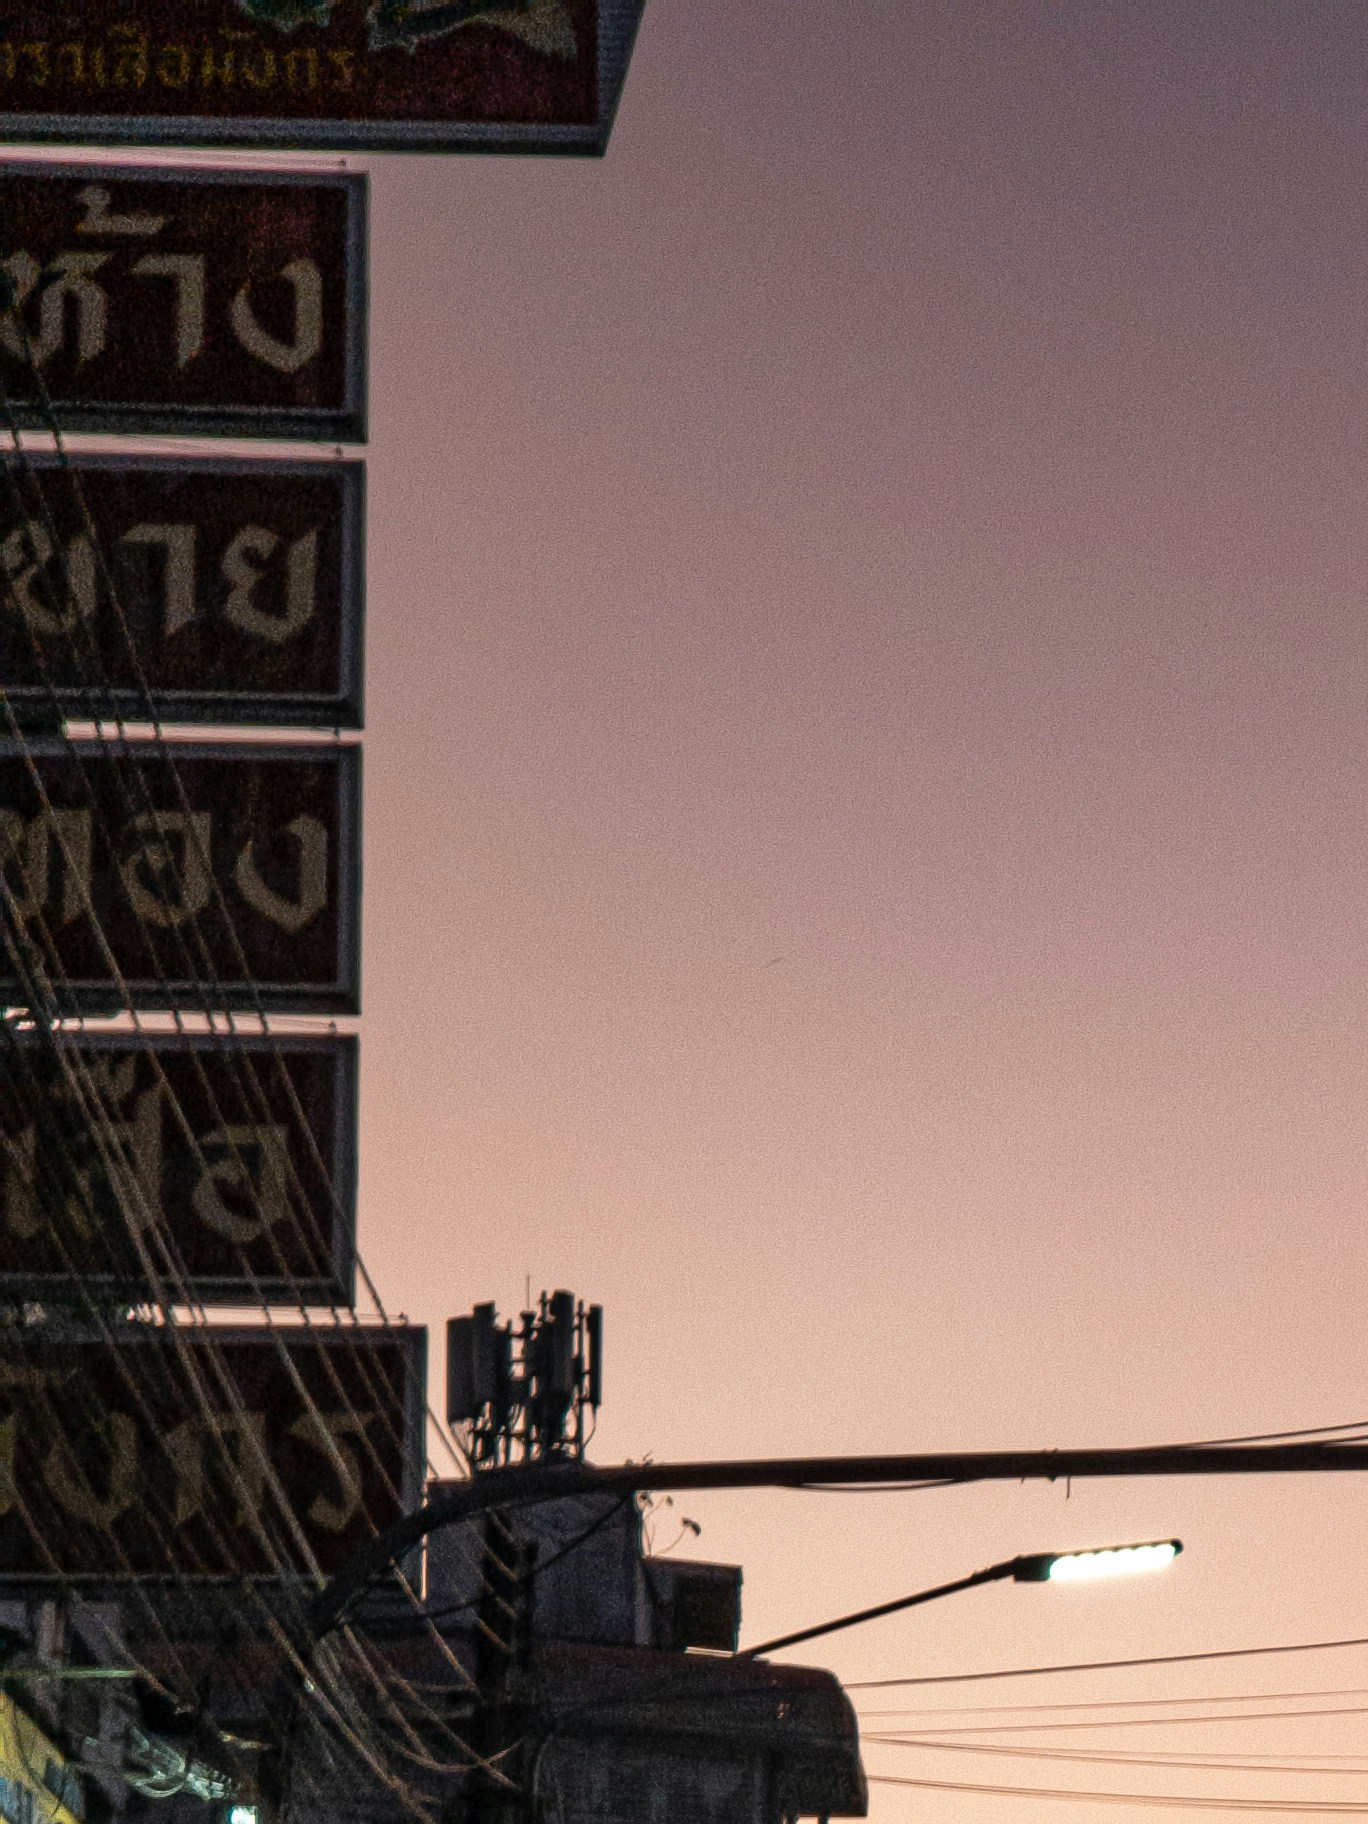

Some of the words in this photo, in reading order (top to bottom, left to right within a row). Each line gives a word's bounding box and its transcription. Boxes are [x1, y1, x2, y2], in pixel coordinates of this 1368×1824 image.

[0, 186, 324, 374] ห้าง
[0, 519, 318, 647] ขาย
[0, 808, 328, 935] ทอง
